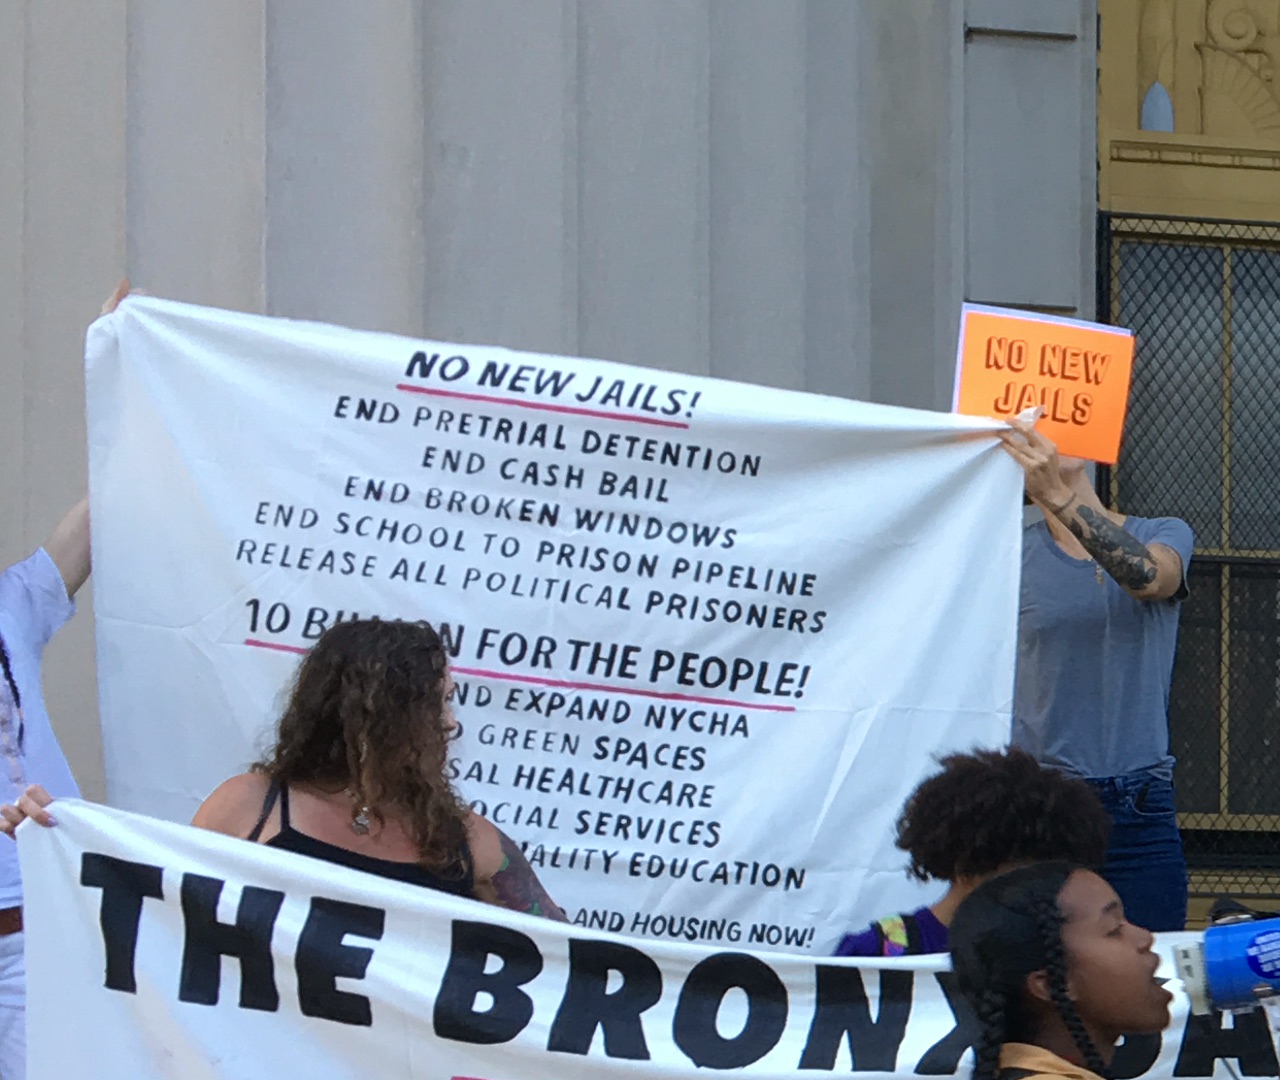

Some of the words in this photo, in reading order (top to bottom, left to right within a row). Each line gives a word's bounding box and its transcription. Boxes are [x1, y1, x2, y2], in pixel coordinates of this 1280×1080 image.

[405, 351, 469, 381] NO
[477, 361, 575, 397] NEW
[575, 376, 702, 418] JAILS!
[985, 336, 1028, 373] NO
[1039, 343, 1112, 386] NEW
[994, 382, 1093, 425] JAILS
[334, 396, 400, 423] END
[413, 406, 566, 449] PRETRIAL
[581, 430, 762, 477] DETENTION
[421, 447, 485, 474] END
[500, 458, 584, 489] CASH
[598, 472, 669, 502] BAIL
[344, 476, 410, 503] END
[426, 488, 560, 527] BROKEN
[575, 508, 737, 549] WINDOWS
[255, 502, 318, 529] END
[334, 512, 465, 551] SCHOOL
[483, 533, 520, 558] TO
[536, 541, 658, 578] PRISON
[672, 557, 817, 596] PIPELINE
[236, 539, 377, 577] RELEASE
[390, 558, 447, 586] ALL
[462, 568, 631, 610] POLITICAL
[645, 590, 827, 634] PRISONERS
[245, 598, 290, 633] 10
[476, 628, 557, 669] FOR
[567, 639, 641, 679] THE
[650, 649, 812, 699] PEOPLE!
[504, 688, 631, 723] EXPAND
[645, 705, 749, 738] NYCHA
[478, 724, 580, 755] GREEN
[593, 736, 707, 771] SPACES
[513, 765, 715, 808] HEALTHCARE
[470, 799, 558, 829] OCIAL
[575, 810, 721, 848] SERVICES
[521, 841, 619, 874] ALITY
[628, 852, 807, 891] EDUCATION
[80, 851, 386, 1029] THE
[573, 907, 624, 932] AND
[631, 912, 742, 943] HOUSING
[748, 923, 814, 948] NOW!
